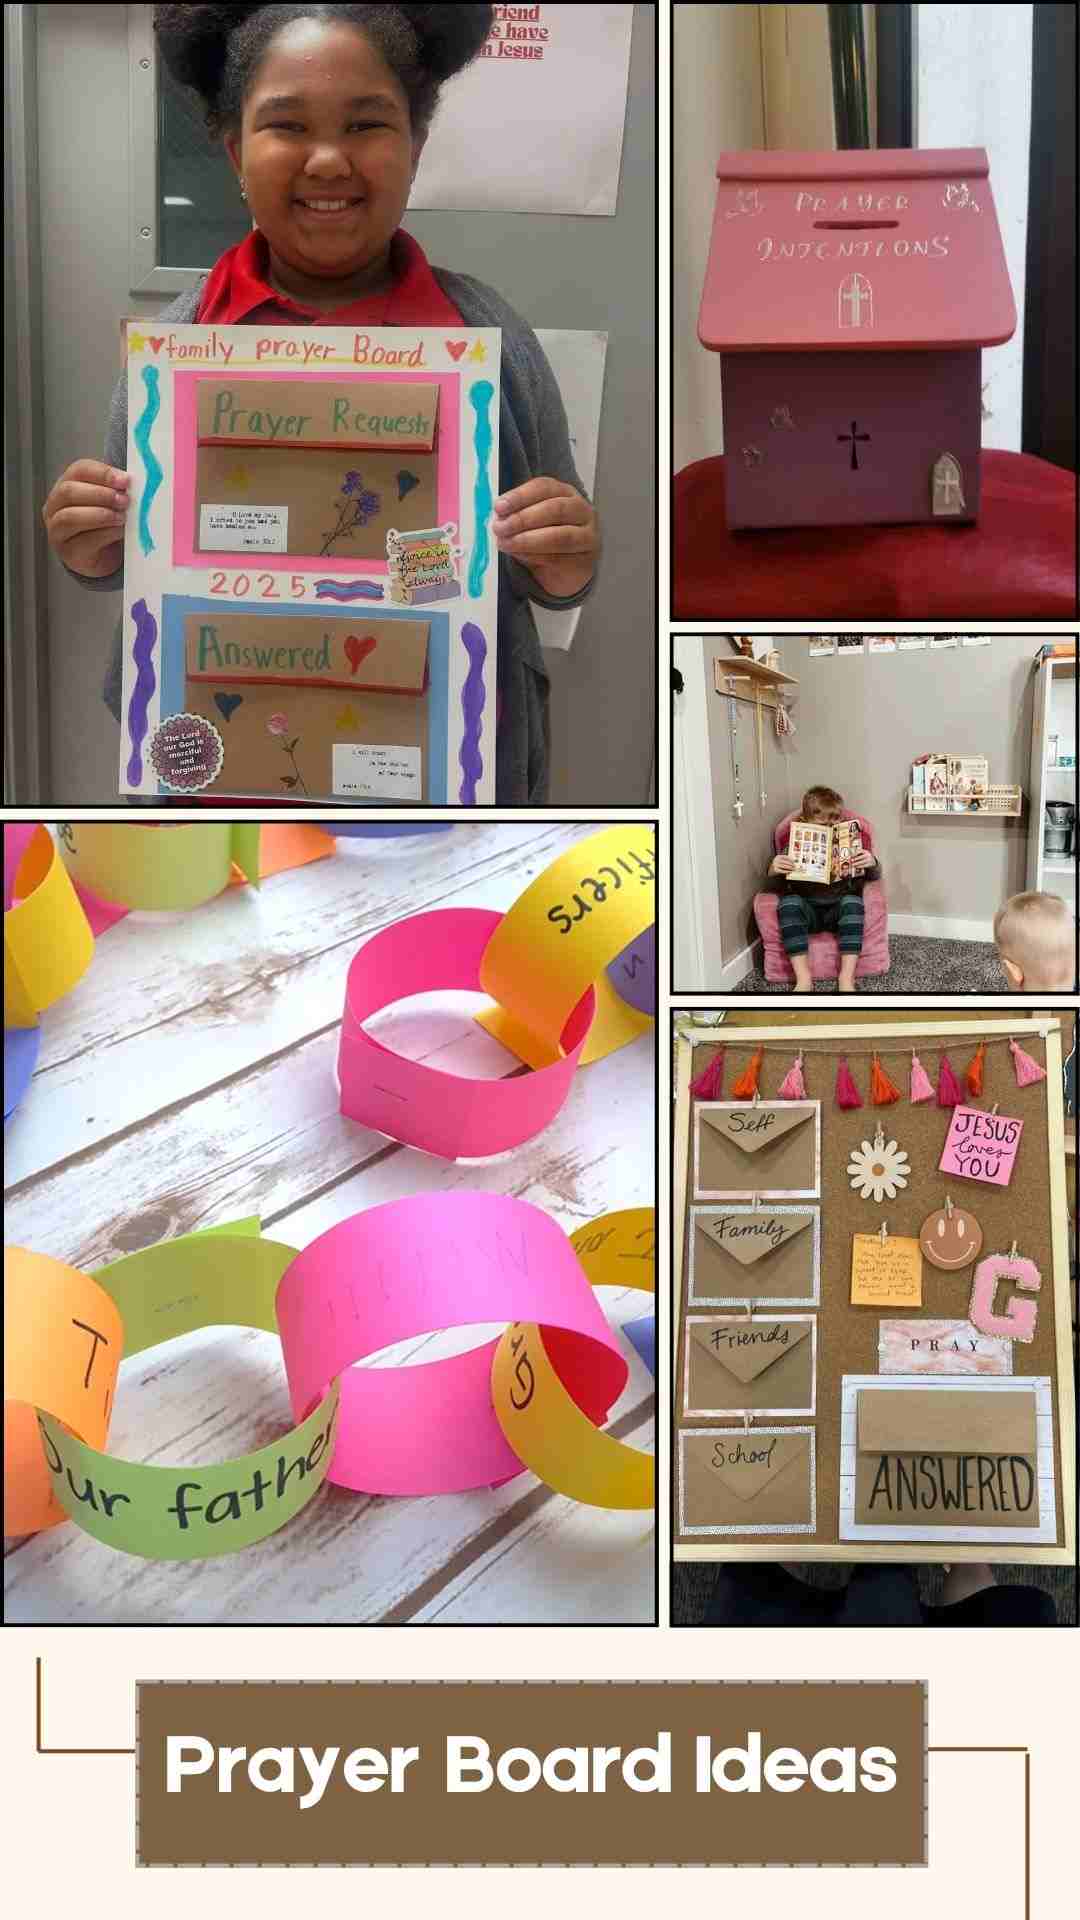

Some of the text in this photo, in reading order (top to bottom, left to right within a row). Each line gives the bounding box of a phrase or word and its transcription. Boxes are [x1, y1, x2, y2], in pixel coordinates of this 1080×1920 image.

[495, 4, 540, 19] riend
[506, 22, 550, 39] have
[497, 41, 544, 57] Jesus
[795, 191, 909, 212] PRAYER
[166, 331, 424, 367] family prayer Board
[213, 390, 430, 440] Prayer Requests
[208, 573, 306, 598] 2025
[197, 624, 332, 672] Answered
[178, 740, 195, 749] God
[181, 729, 200, 739] Lord
[548, 848, 655, 934] ficers
[955, 1113, 1020, 1143] JESUS
[954, 1153, 1001, 1177] YOU
[713, 1216, 791, 1245] Family
[712, 1323, 789, 1350] Friends
[911, 1339, 980, 1352] PRAY
[712, 1438, 777, 1468] School
[868, 1454, 1035, 1511] ANSWERED
